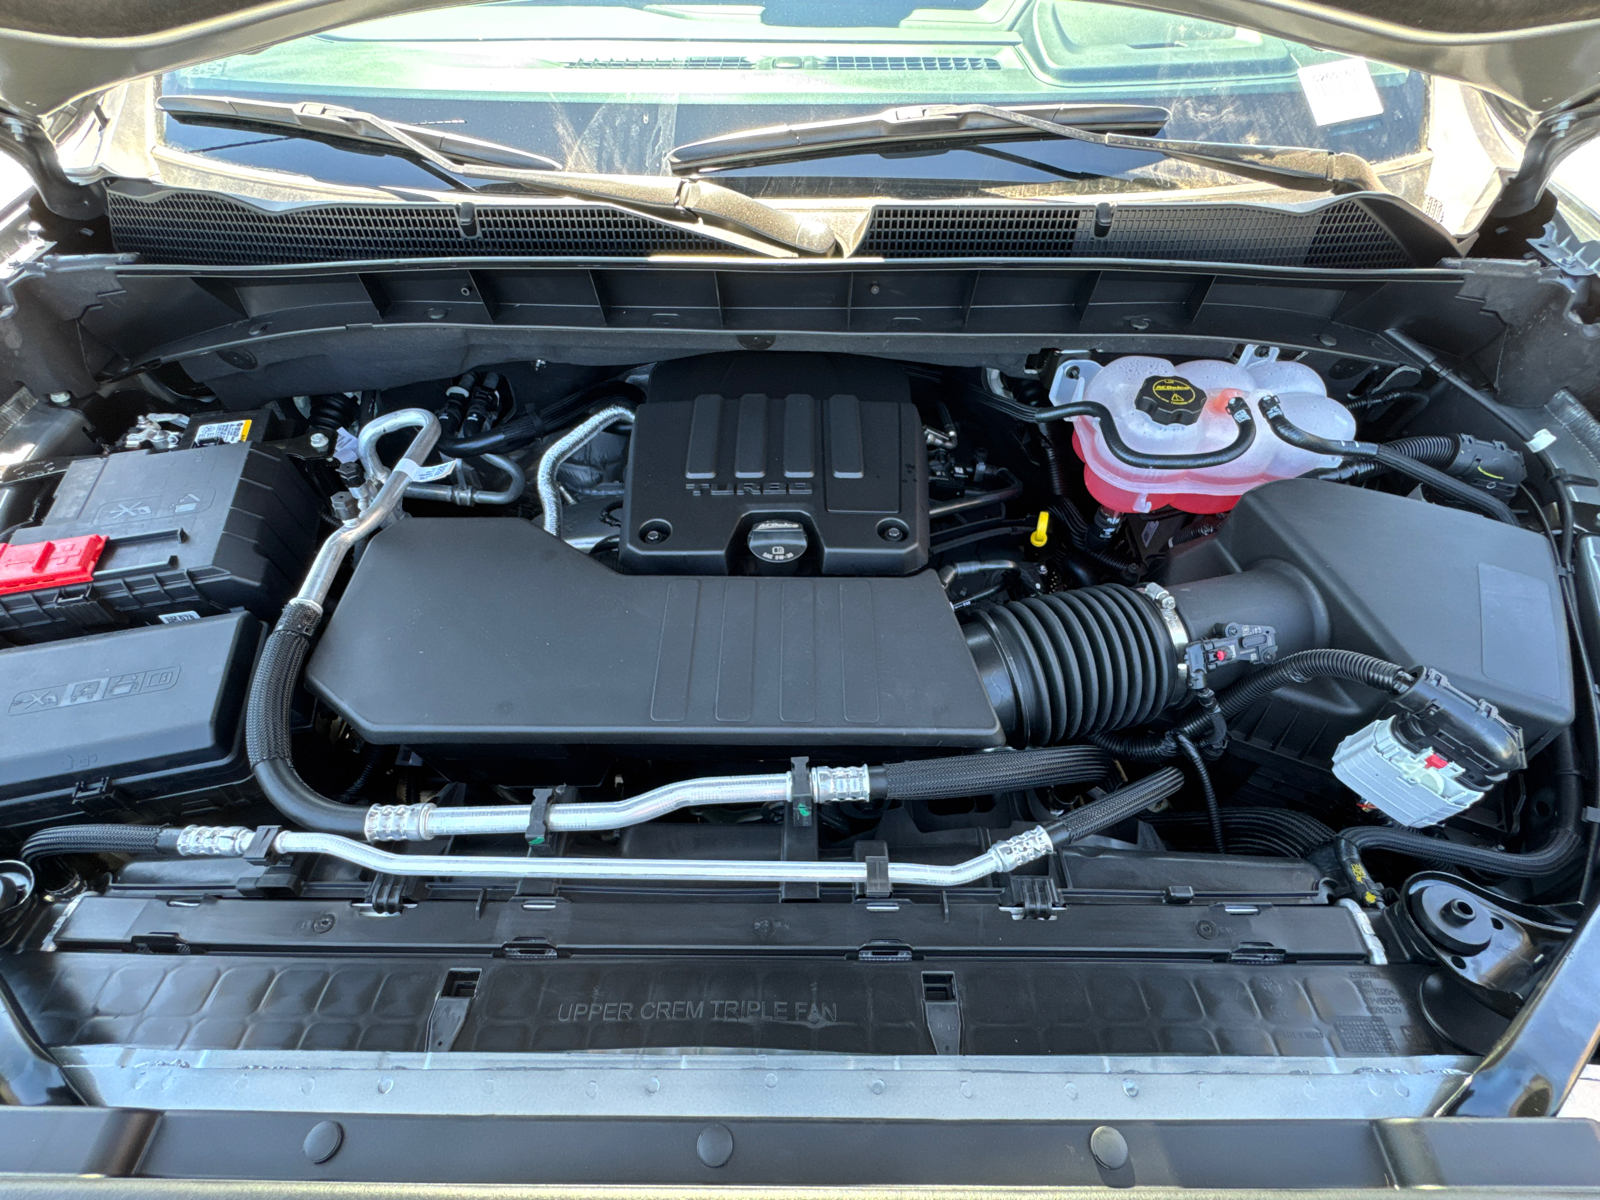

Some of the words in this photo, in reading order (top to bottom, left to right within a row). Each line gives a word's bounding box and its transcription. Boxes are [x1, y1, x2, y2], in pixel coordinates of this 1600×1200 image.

[685, 482, 813, 497] TURBO
[755, 522, 799, 530] ACDelco
[762, 552, 774, 560] SAE
[557, 1002, 634, 1021] UPPER
[710, 1000, 788, 1021] TRIPLE
[794, 1001, 837, 1022] FAN
